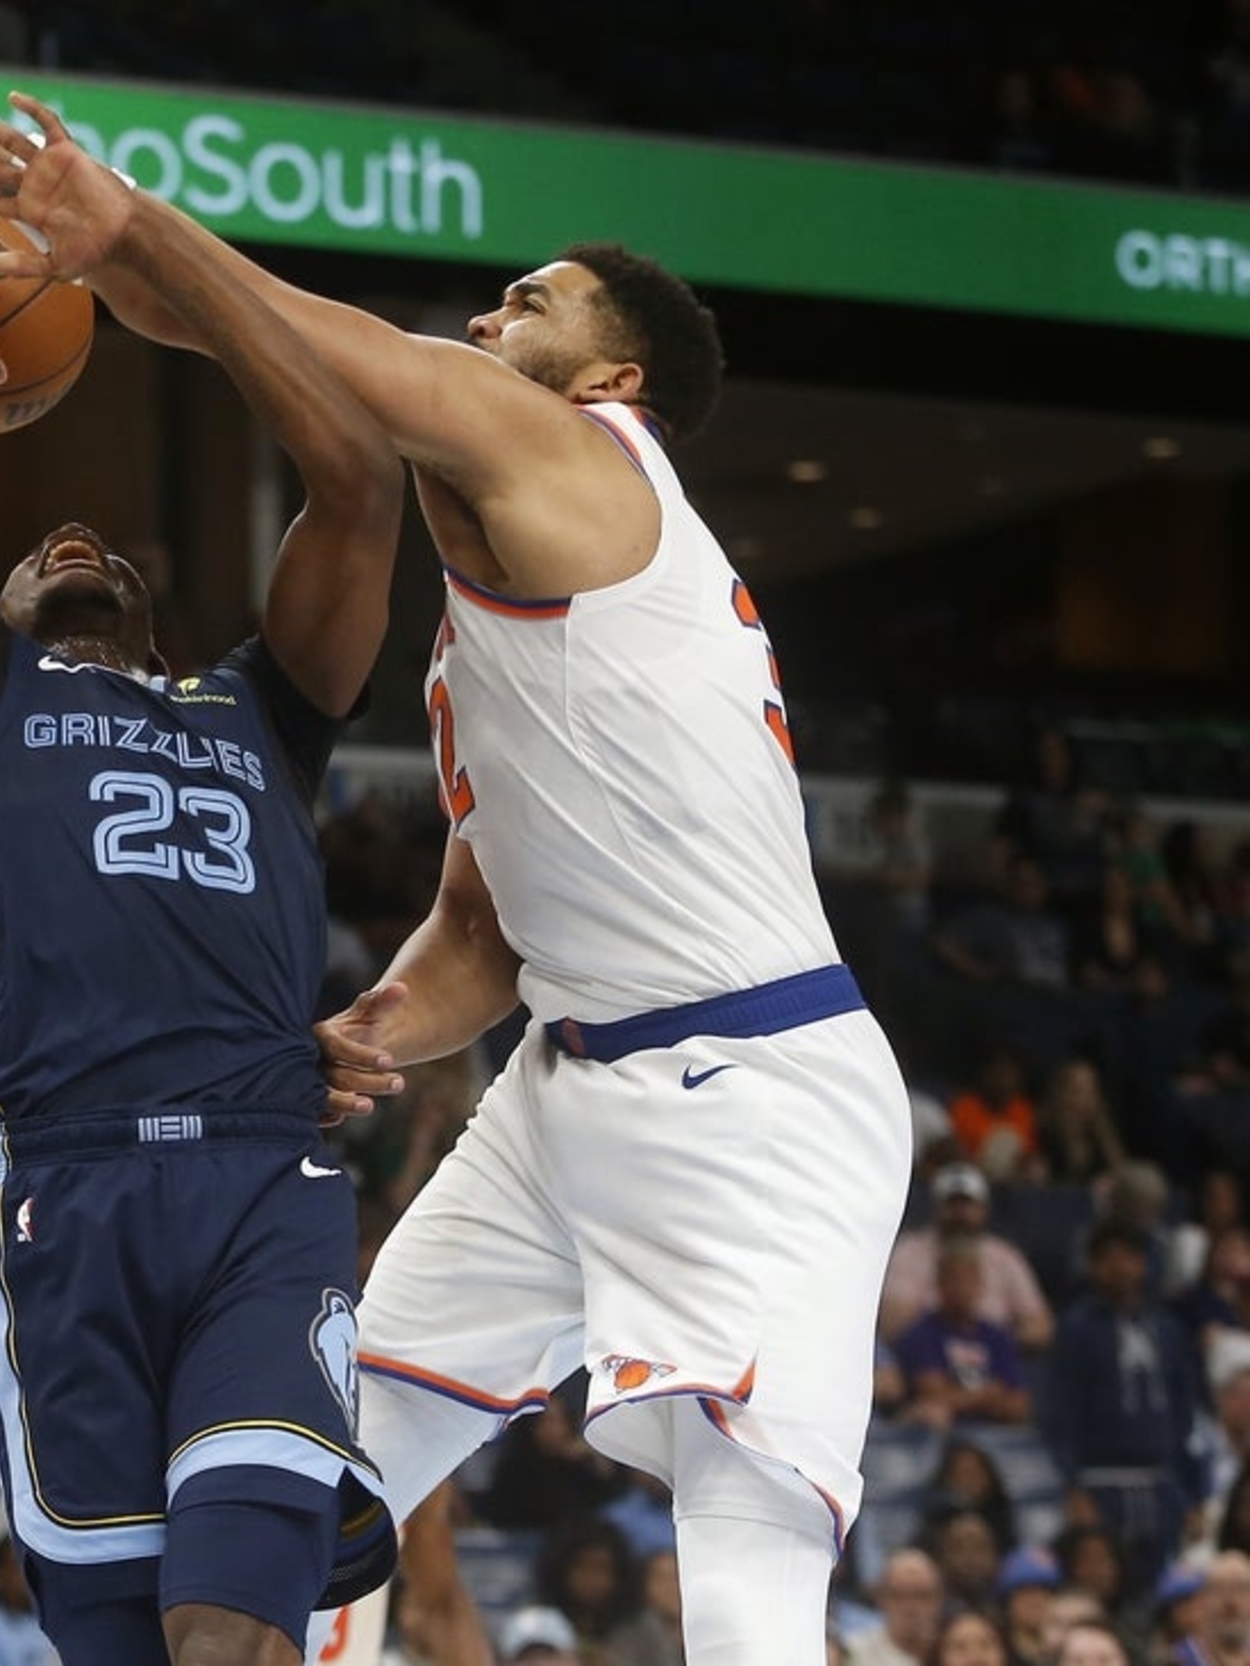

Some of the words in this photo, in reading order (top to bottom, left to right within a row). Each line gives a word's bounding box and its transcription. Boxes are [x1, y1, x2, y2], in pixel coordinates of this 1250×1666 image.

[24, 713, 266, 793] GRIZZLIES
[429, 674, 476, 832] 2
[89, 770, 256, 894] 23
